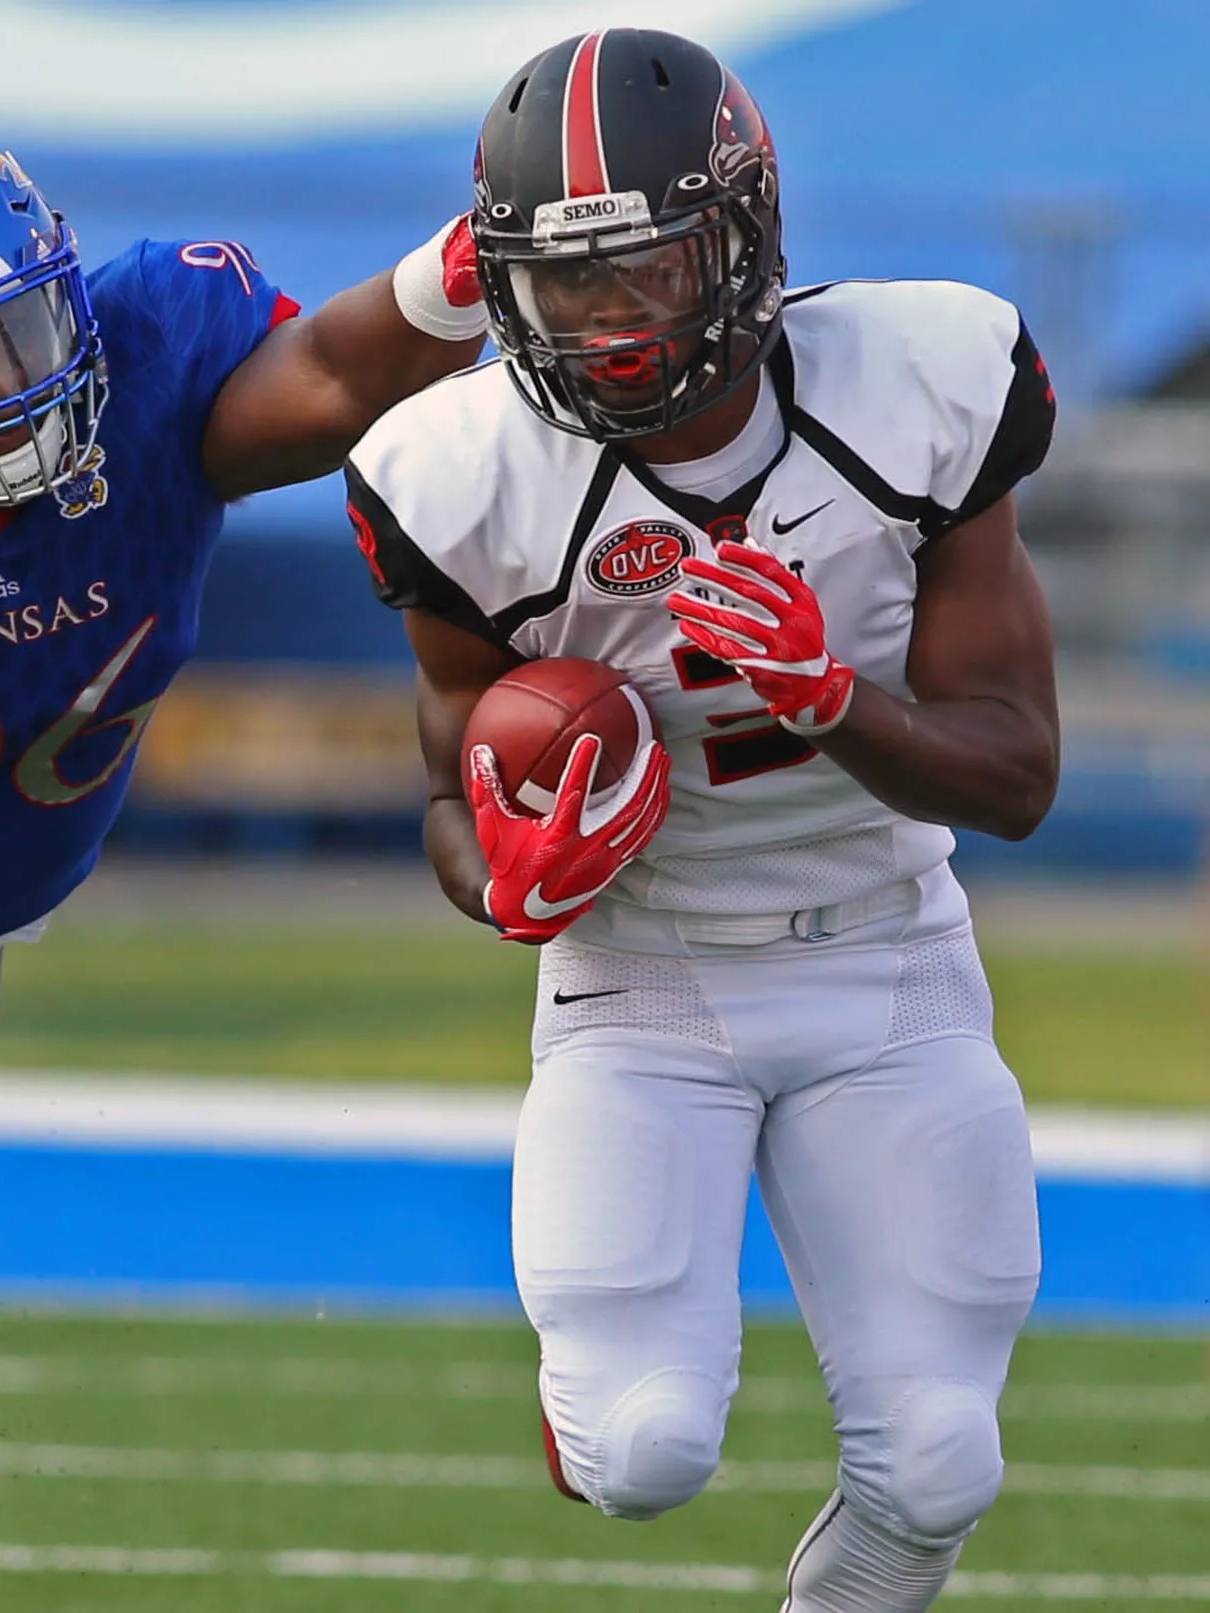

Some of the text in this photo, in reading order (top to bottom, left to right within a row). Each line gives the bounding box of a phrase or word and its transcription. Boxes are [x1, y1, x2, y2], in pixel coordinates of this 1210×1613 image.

[563, 200, 617, 221] SEMO
[612, 540, 668, 578] OVC
[609, 565, 677, 592] CONFERENC
